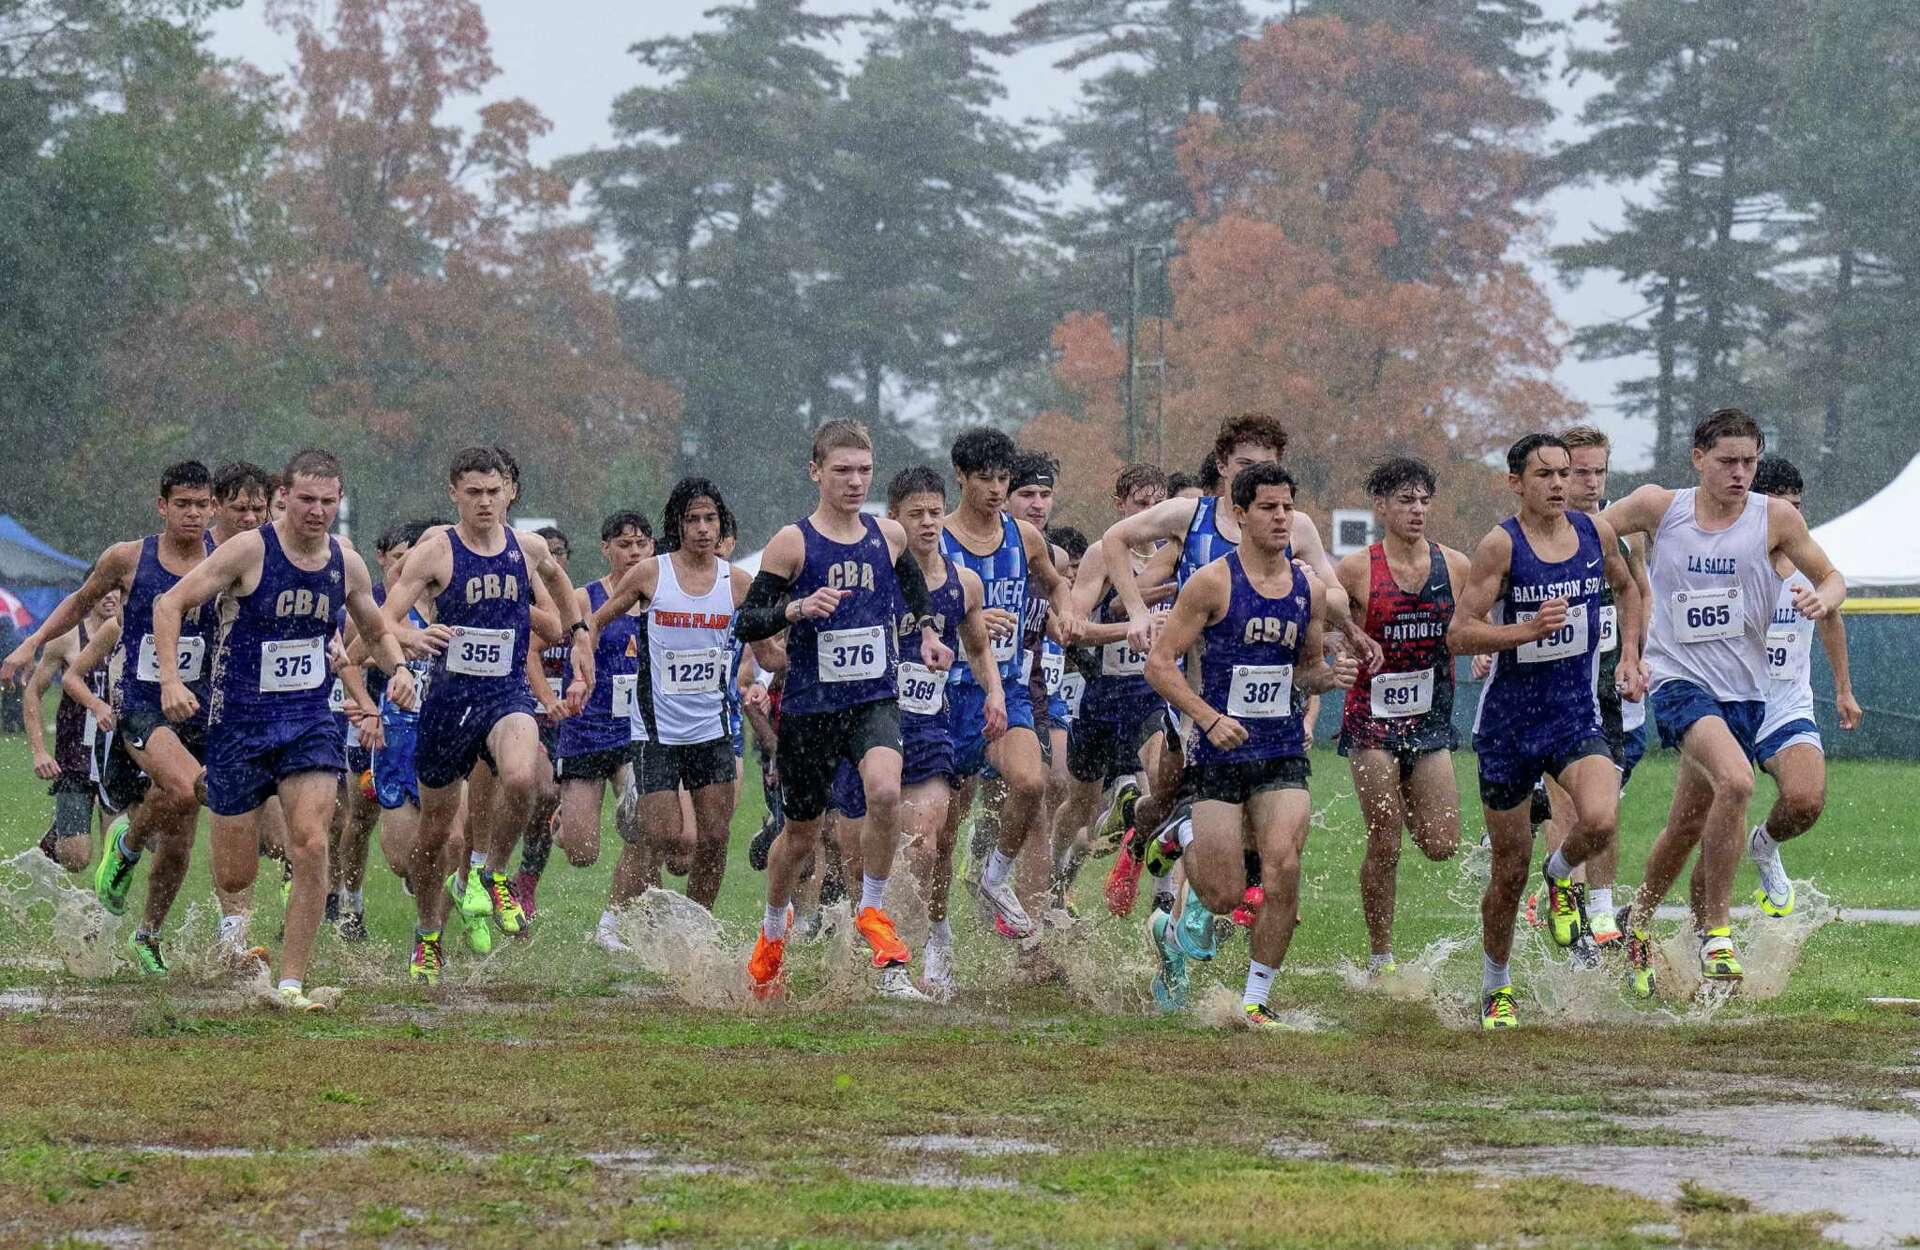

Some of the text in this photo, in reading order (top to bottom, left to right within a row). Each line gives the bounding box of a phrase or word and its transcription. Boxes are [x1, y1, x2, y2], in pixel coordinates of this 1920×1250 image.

[827, 560, 875, 593] CBA
[1688, 555, 1736, 575] LA SALLE
[466, 573, 519, 605] CBA
[1513, 580, 1581, 603] BALLSTON
[275, 589, 330, 623] CBA
[1686, 605, 1730, 628] 665
[1243, 616, 1298, 650] CBA
[1384, 623, 1443, 640] PATRIOTS
[461, 642, 501, 664] 355
[832, 644, 875, 668] 376
[274, 655, 312, 678] 375
[668, 662, 715, 682] 1225
[902, 678, 936, 701] 369
[1243, 682, 1281, 703] 387
[1384, 684, 1419, 705] 891
